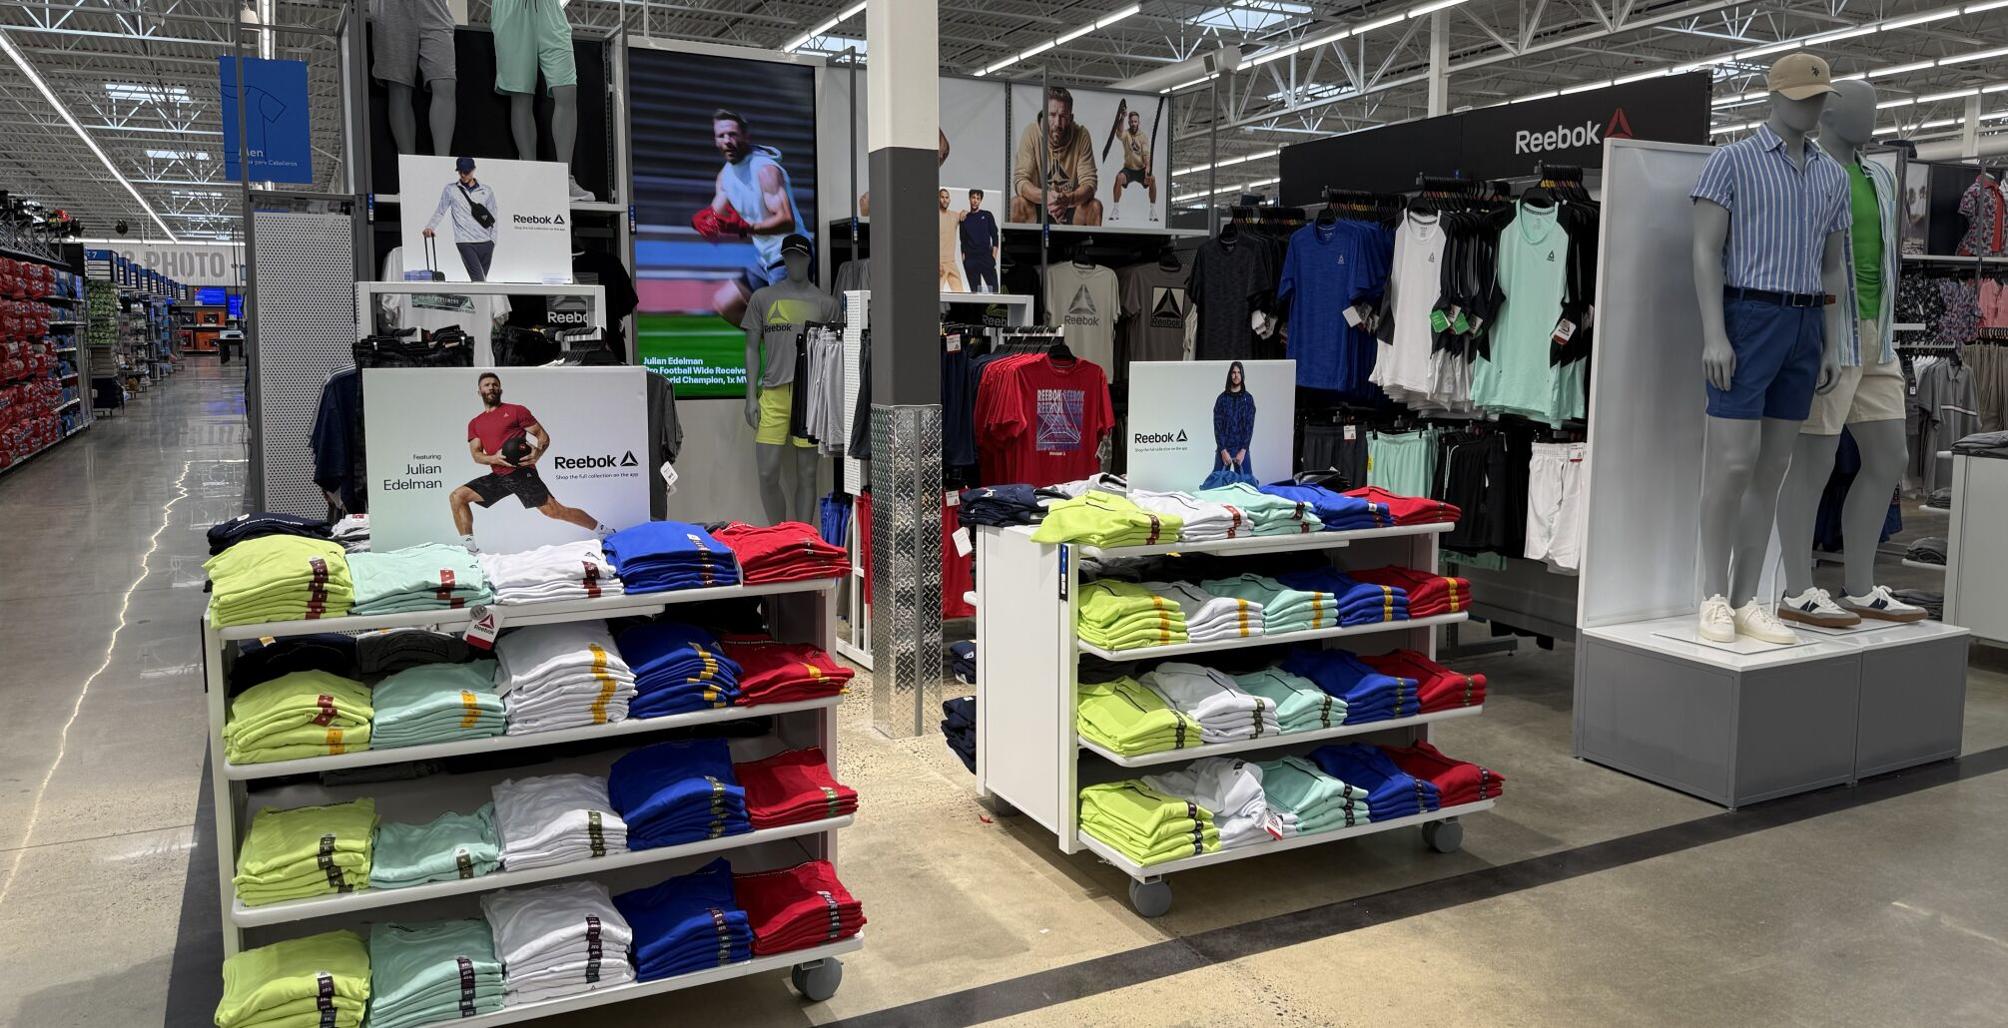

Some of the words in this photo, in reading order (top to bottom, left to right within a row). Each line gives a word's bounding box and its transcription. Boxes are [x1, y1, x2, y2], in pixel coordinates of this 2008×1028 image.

[1515, 120, 1601, 155] Reebok
[512, 214, 552, 224] Reebok
[145, 252, 226, 278] PHOTO
[547, 311, 588, 323] Reebo
[1064, 315, 1099, 326] Reebok
[644, 357, 667, 365] Julian
[668, 357, 704, 365] Edelman
[660, 366, 692, 374] Football
[693, 366, 714, 374] Wide
[715, 366, 747, 374] Receive
[682, 376, 726, 385] Champion,
[1134, 432, 1174, 444] Reebok
[554, 454, 617, 470] Reebok
[405, 463, 442, 475] Julian
[383, 478, 443, 491] Edelman
